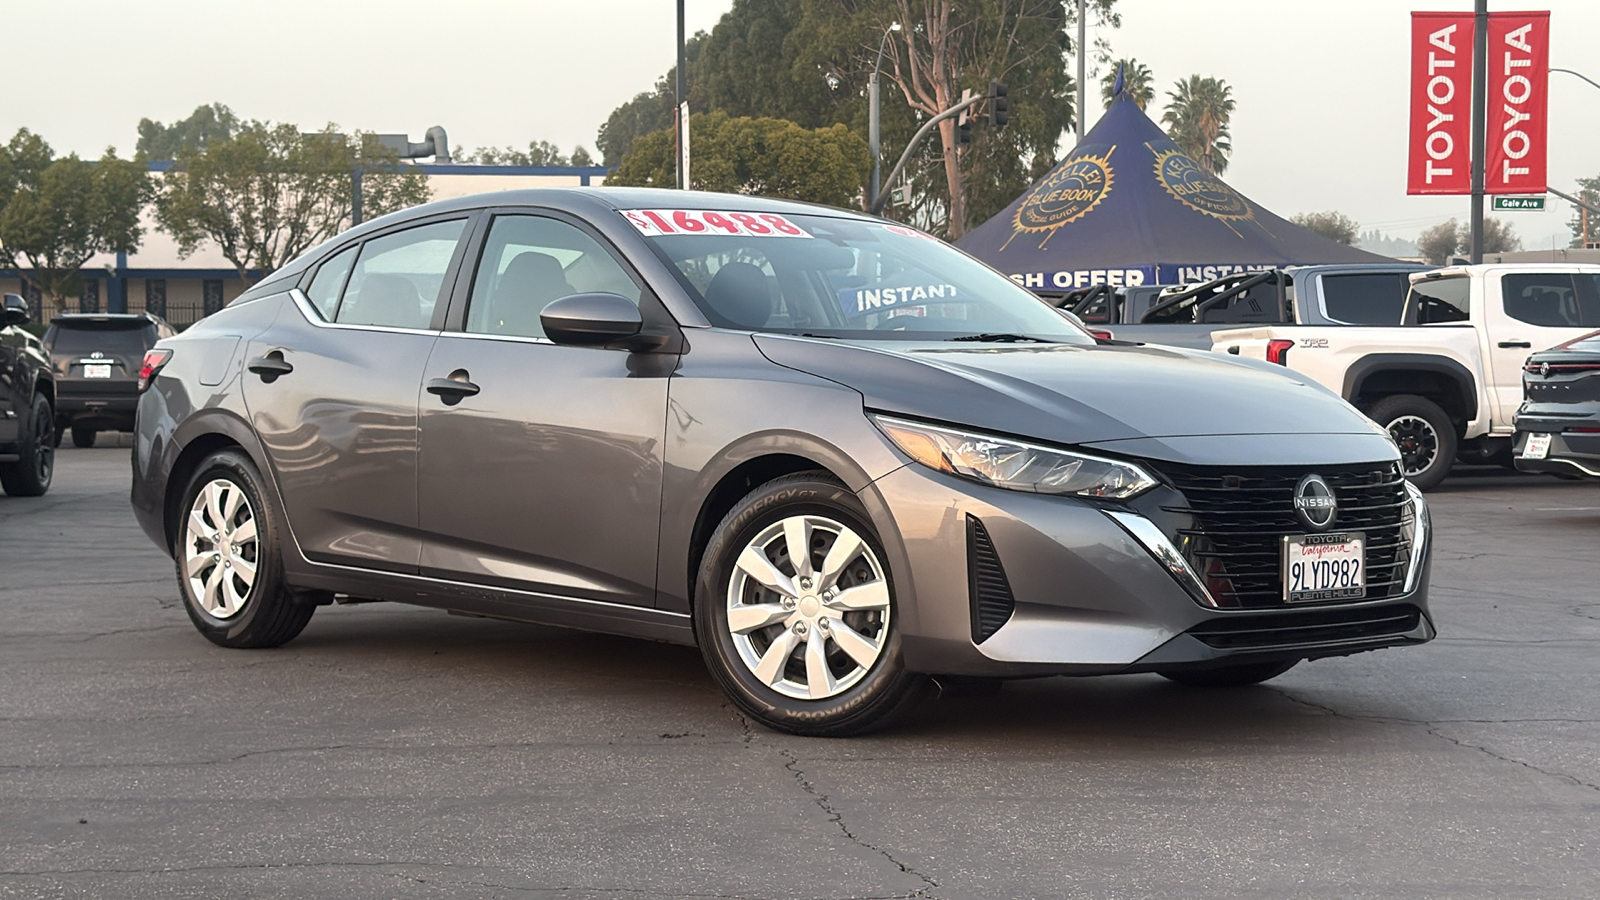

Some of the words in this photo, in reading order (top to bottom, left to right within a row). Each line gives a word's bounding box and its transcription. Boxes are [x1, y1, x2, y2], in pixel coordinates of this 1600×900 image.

[1426, 24, 1457, 184] TOYOTA
[1503, 23, 1532, 183] TOYOTA
[1048, 165, 1102, 187] KELLEY
[1166, 158, 1203, 178] KELL
[1172, 181, 1208, 195] BLUE
[1027, 190, 1062, 206] BLUE
[1059, 189, 1099, 201] BOOK
[1502, 199, 1520, 208] Gale
[1521, 199, 1538, 208] Ave
[1049, 205, 1079, 221] GUIDE
[626, 210, 804, 235] $16488
[1053, 270, 1144, 288] OFFER
[857, 284, 957, 311] INSTANT
[1297, 498, 1336, 507] NISSAN
[1307, 535, 1347, 544] TOYOTA
[1302, 545, 1350, 559] California
[1292, 559, 1359, 591] 9LYD982
[1291, 589, 1332, 601] PUENTE
[1333, 587, 1362, 598] HILLS
